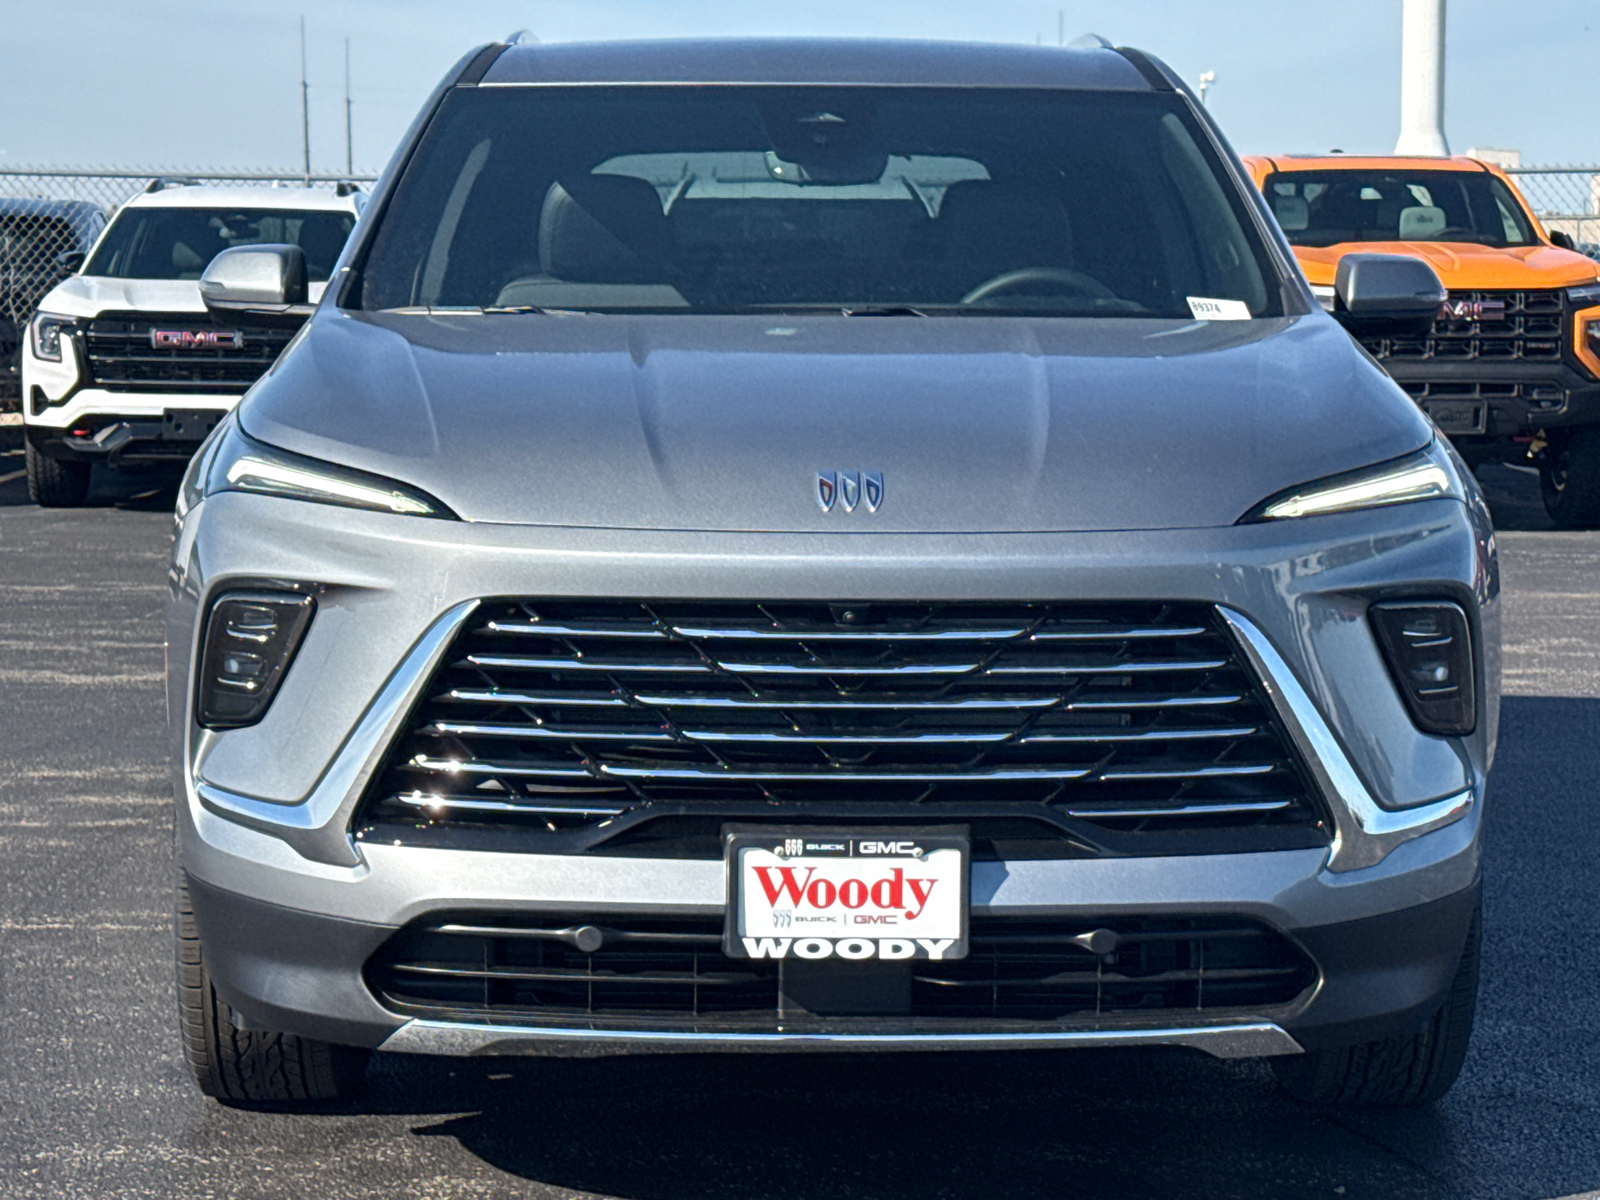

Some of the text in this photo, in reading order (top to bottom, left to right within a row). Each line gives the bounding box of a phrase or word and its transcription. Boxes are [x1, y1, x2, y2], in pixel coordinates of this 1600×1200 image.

[1437, 302, 1504, 319] MC
[156, 331, 234, 346] GMC
[806, 841, 915, 854] BUICK GMC
[752, 866, 939, 919] Woody
[795, 915, 898, 925] BUICK GMC
[742, 938, 955, 959] WOODY
